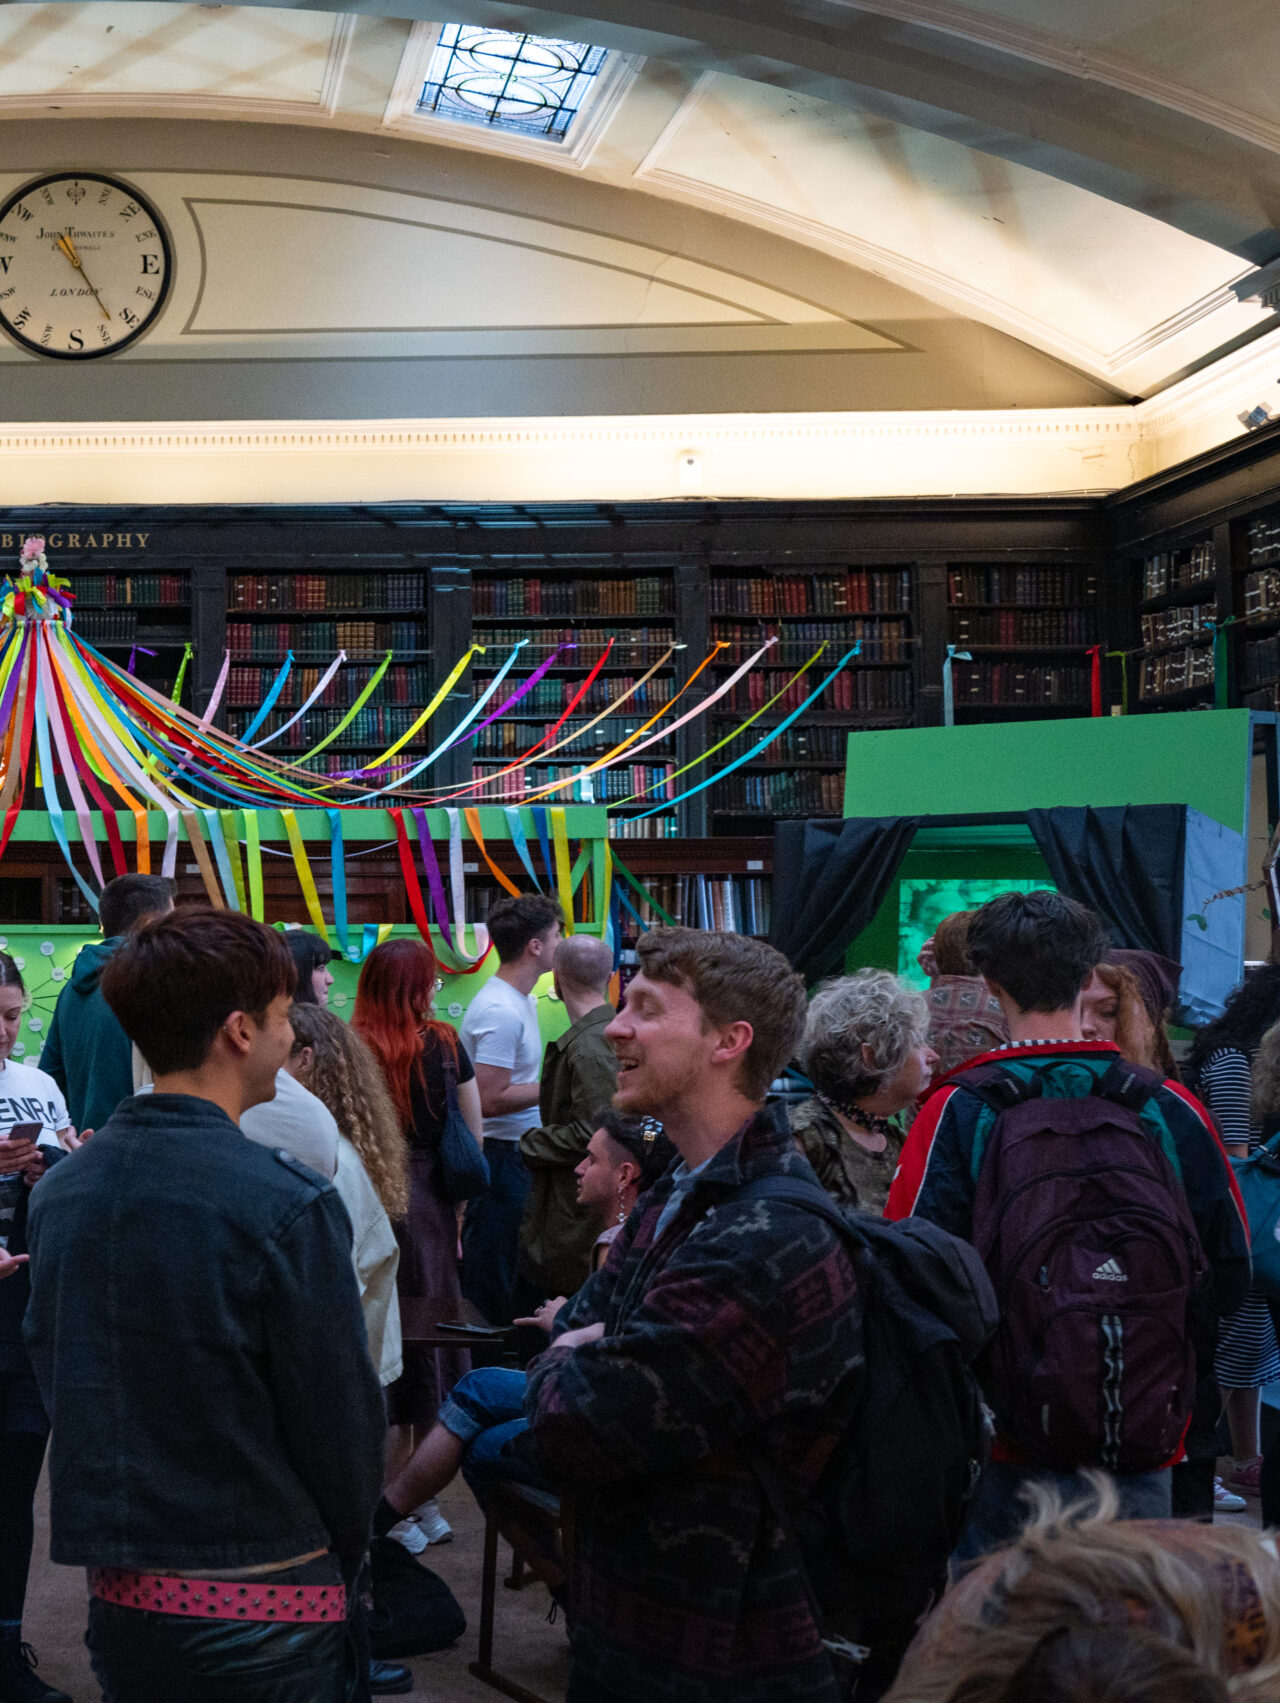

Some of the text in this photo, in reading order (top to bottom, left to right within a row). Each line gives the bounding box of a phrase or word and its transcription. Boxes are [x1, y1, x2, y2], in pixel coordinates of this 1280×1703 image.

[40, 187, 55, 206] NNW
[98, 186, 113, 206] NNE
[11, 203, 34, 222] NW
[119, 202, 141, 222] NE
[135, 228, 157, 243] ENE
[140, 254, 160, 274] E
[50, 287, 102, 297] LONDON
[135, 286, 156, 301] ESE
[13, 306, 32, 330] SW
[119, 307, 140, 328] SE
[40, 323, 54, 346] SSW
[68, 328, 84, 351] S
[97, 323, 112, 345] SSE
[1092, 1272, 1128, 1282] adidas
